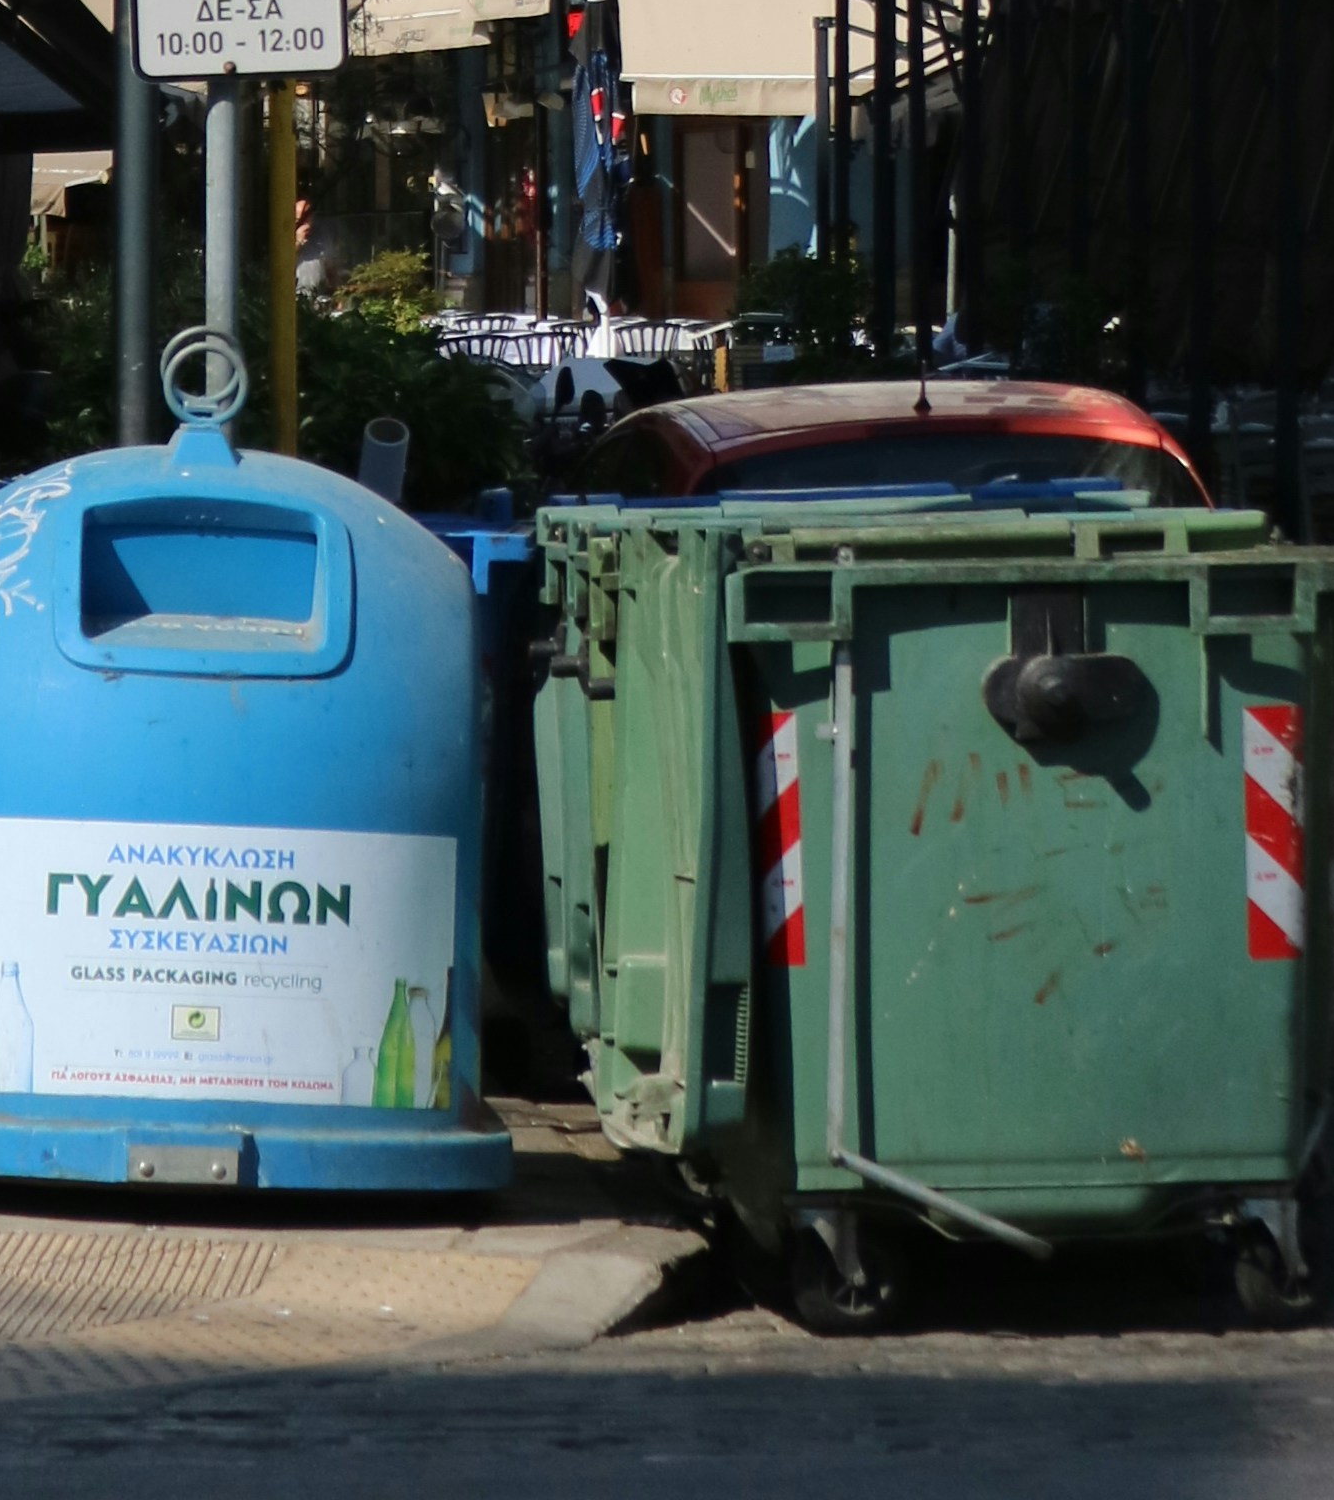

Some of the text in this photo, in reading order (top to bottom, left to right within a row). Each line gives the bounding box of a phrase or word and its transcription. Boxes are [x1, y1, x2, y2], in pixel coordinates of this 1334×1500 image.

[157, 31, 224, 56] 10:00
[258, 27, 325, 52] 12:00
[107, 843, 295, 870] ΑΝΑΚΥΚΛΩΣΗ
[46, 871, 351, 928] ΓΥΑΛΙΝΩΝ
[108, 928, 289, 955] ΣΥΣΚΕΥΑΣΙΩΝ
[70, 965, 323, 993] GLASS PACKAGING recycling
